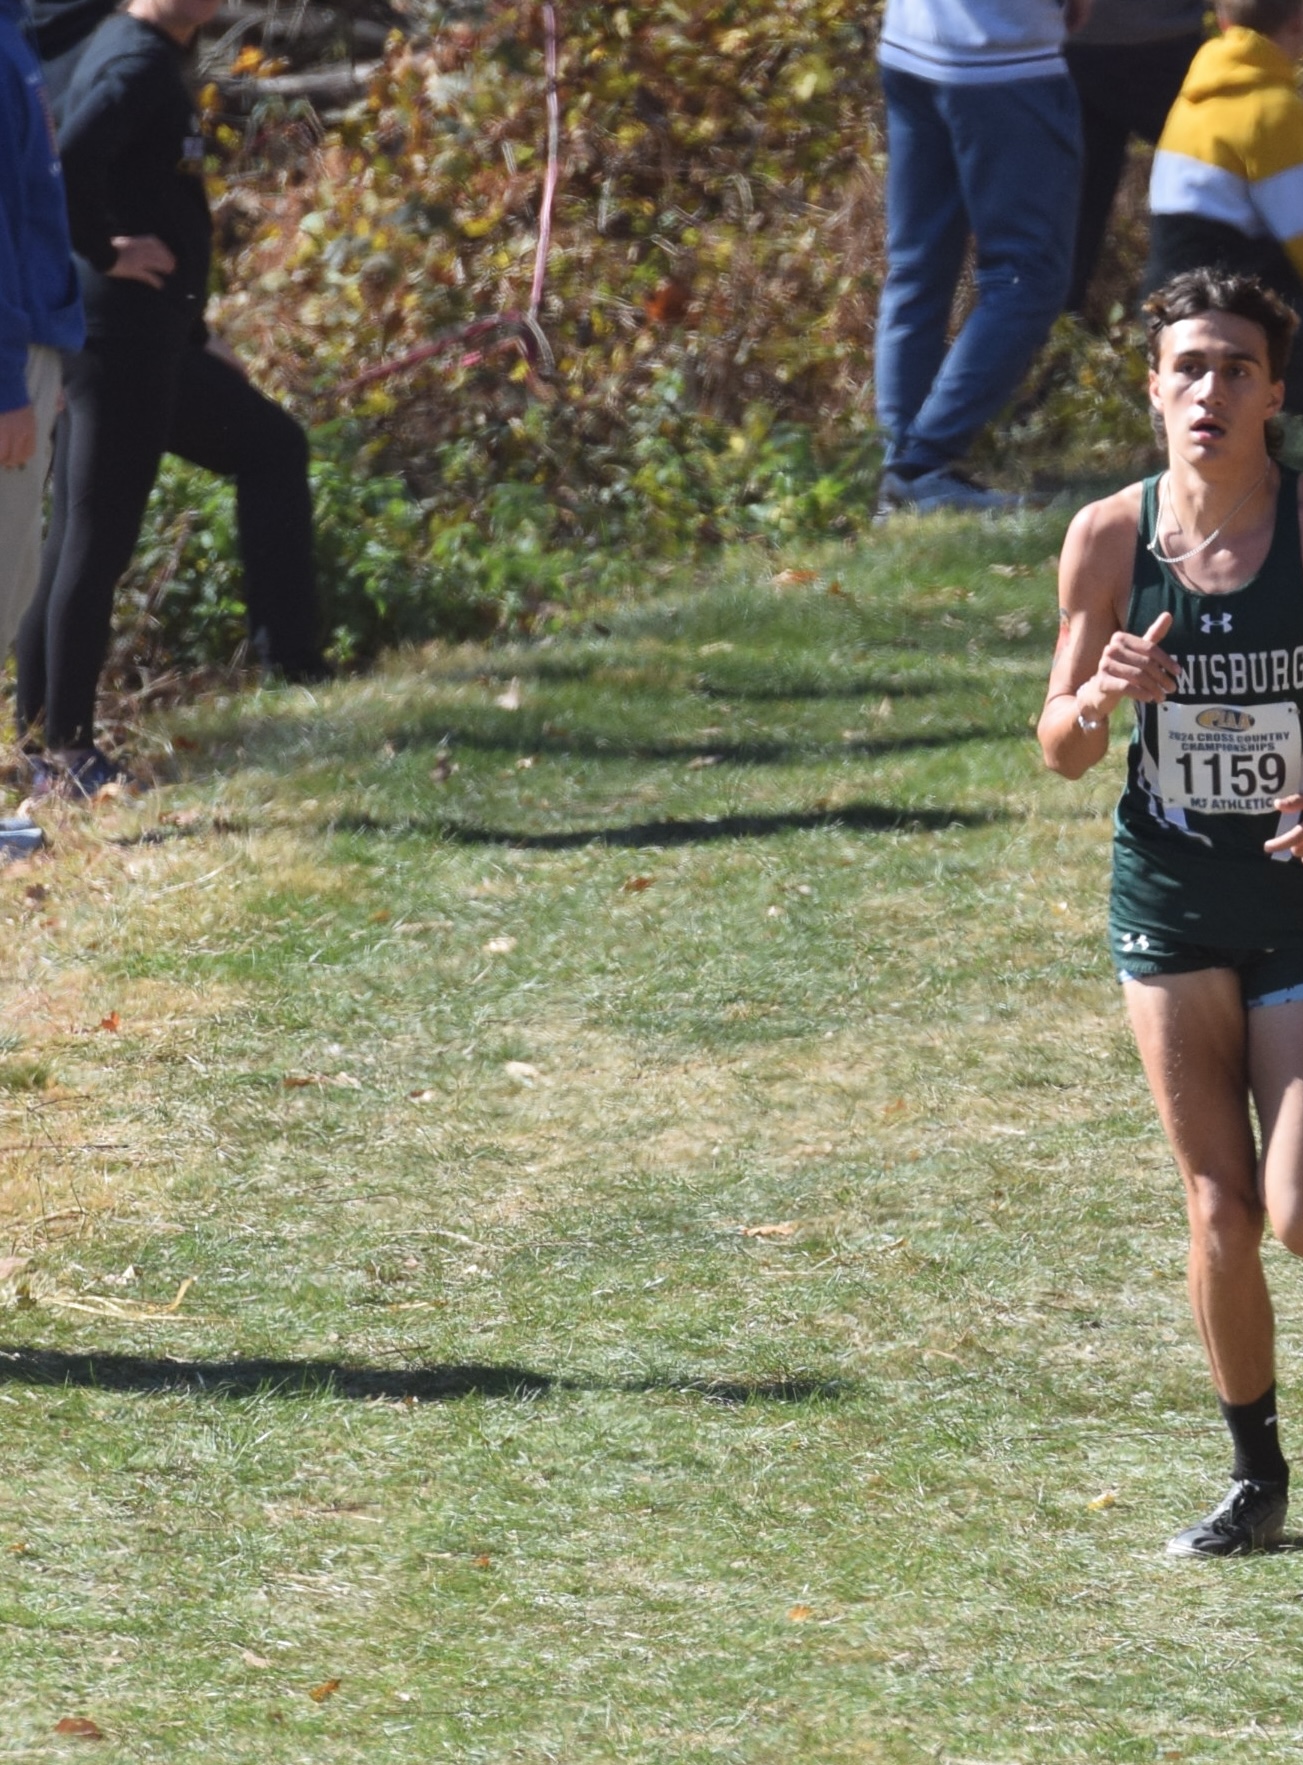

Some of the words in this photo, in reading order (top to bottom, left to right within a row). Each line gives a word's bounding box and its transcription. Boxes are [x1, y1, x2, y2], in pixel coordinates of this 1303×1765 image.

[1168, 730, 1194, 741] 2024
[1197, 732, 1233, 742] CROSS
[1236, 731, 1290, 743] COUNTRY
[1181, 742, 1275, 752] CHAMPIONSHIPS
[1176, 752, 1286, 796] 1159
[1211, 797, 1273, 810] ATHLETIC
